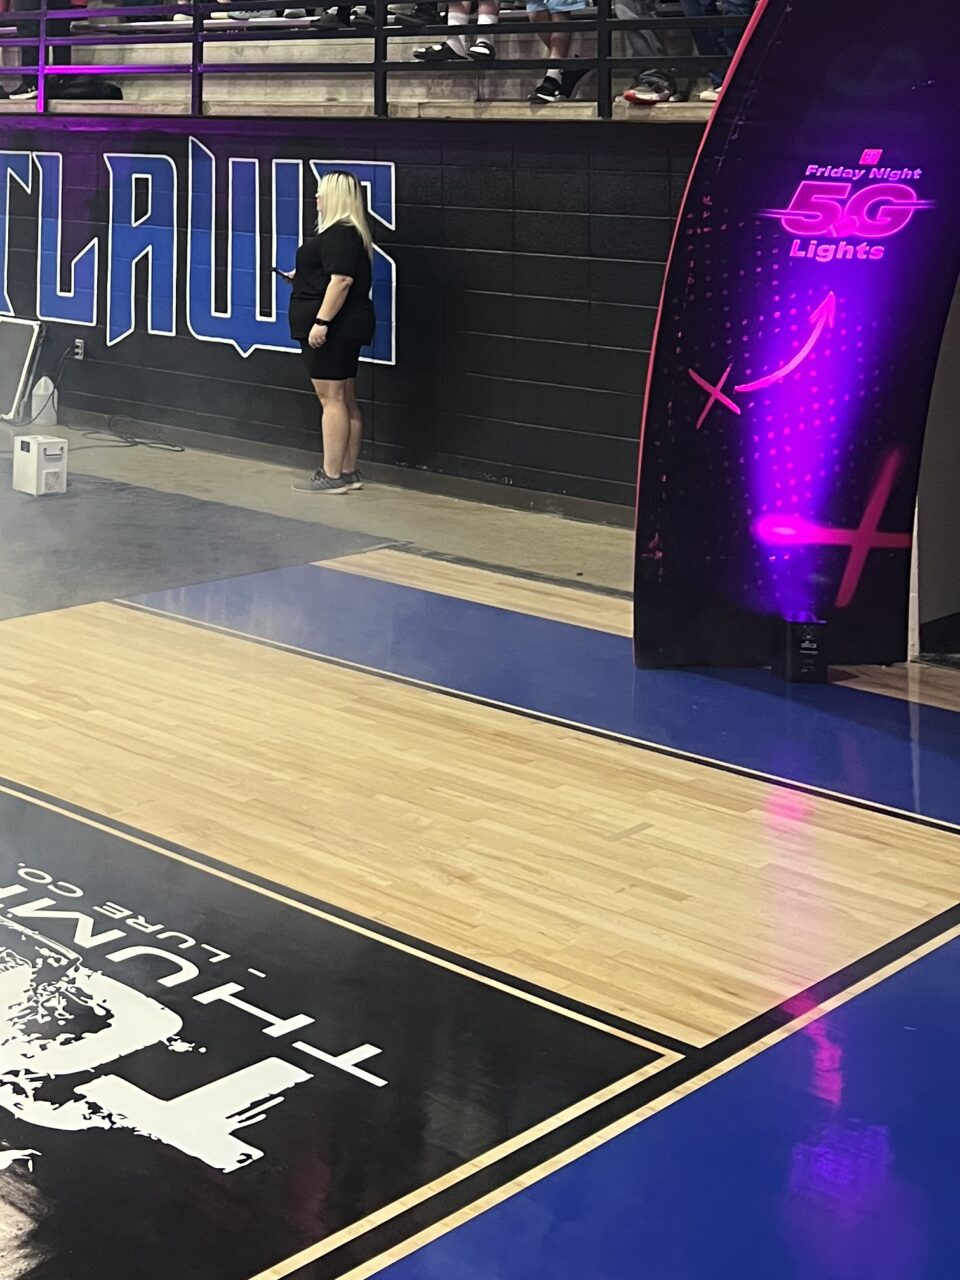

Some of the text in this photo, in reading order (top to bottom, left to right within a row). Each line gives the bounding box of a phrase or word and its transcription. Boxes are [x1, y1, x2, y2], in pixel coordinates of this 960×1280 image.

[805, 164, 922, 180] Friday Night
[781, 180, 917, 238] 5G
[790, 239, 885, 262] Lights
[17, 862, 232, 964] LURE CO.
